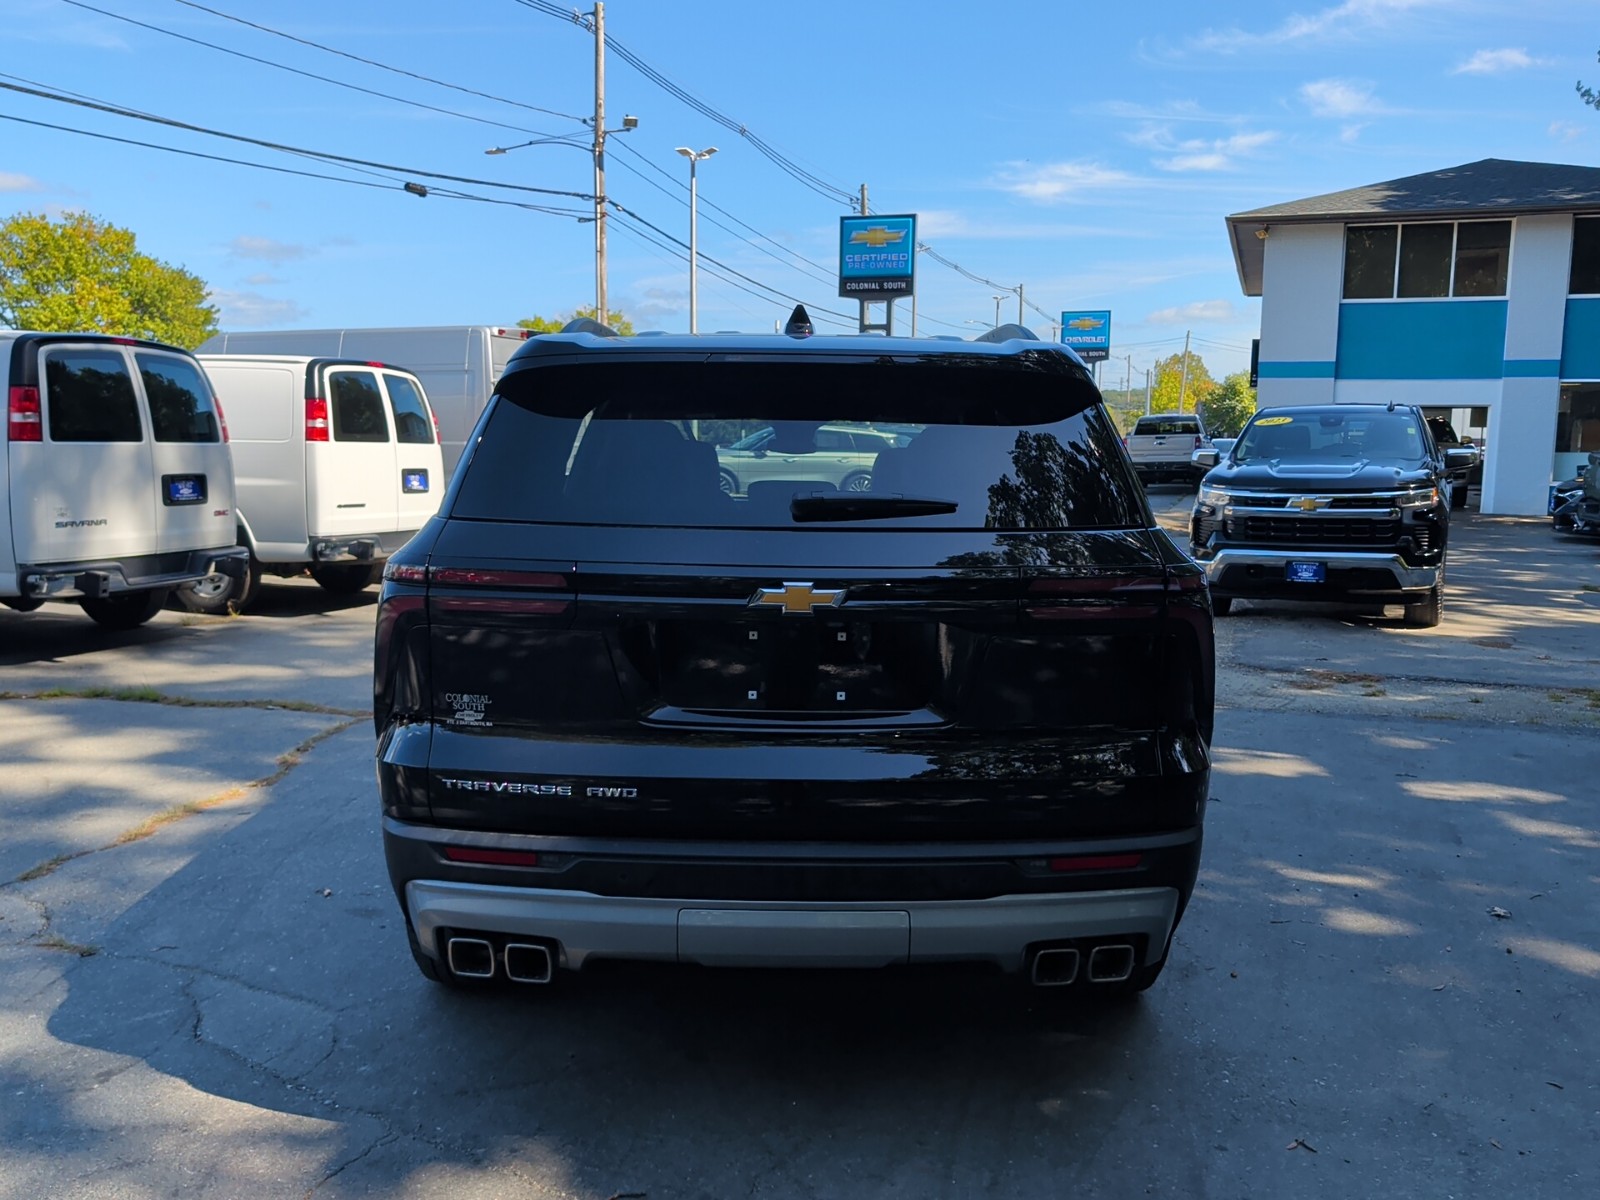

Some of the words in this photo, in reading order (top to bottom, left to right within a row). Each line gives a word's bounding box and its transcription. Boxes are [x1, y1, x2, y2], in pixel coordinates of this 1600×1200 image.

[845, 253, 908, 262] CERTIFIED
[848, 261, 905, 269] PRE-OWNED
[846, 282, 880, 290] COLONIAL
[883, 281, 906, 290] SOUTH
[213, 509, 230, 517] GMC
[55, 519, 108, 528] SAVANA
[445, 693, 492, 704] COLONIAL
[452, 702, 485, 711] SOUTH
[442, 778, 572, 796] TRAVERSE
[586, 787, 637, 797] AWD
